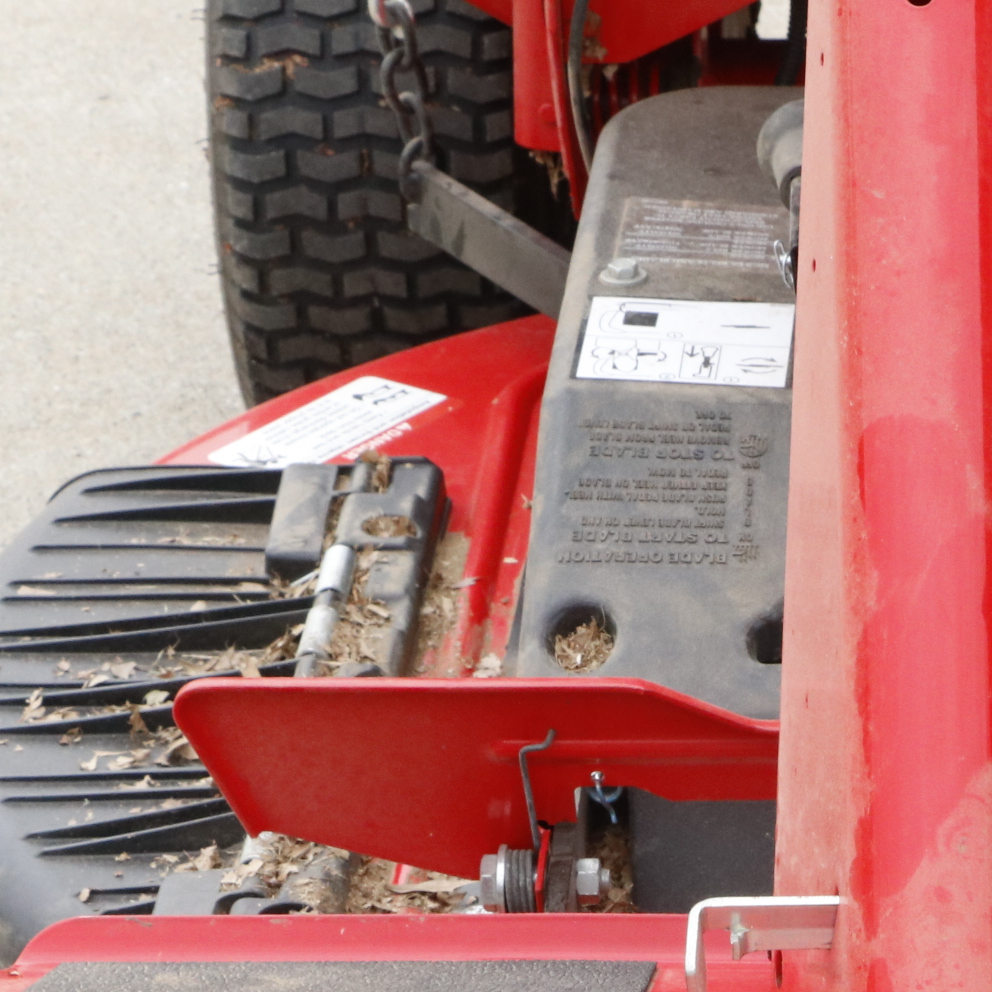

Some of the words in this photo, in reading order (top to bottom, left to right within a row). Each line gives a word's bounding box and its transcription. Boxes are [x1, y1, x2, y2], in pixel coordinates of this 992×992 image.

[590, 447, 649, 460] BLADE
[656, 449, 704, 461] STOP
[572, 531, 633, 543] BLADE
[638, 533, 698, 544] START
[558, 552, 663, 564] OPERATION
[669, 553, 727, 565] BLADE
